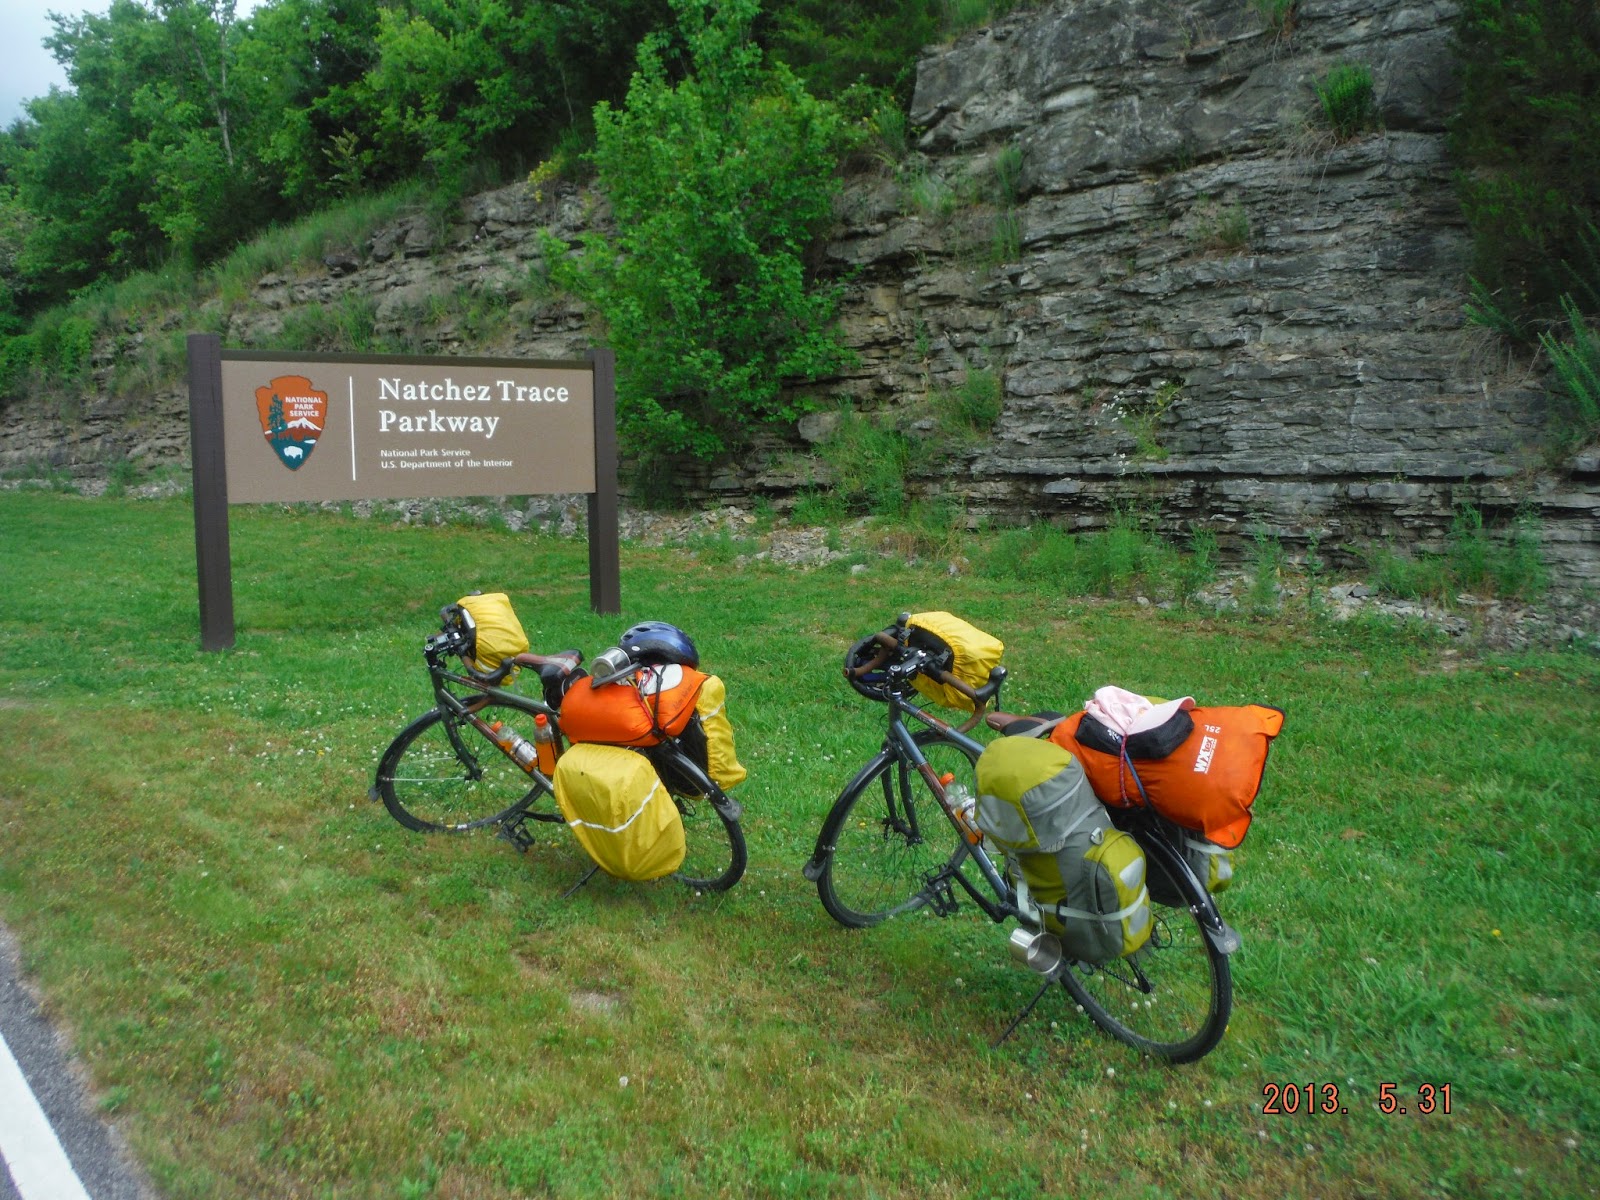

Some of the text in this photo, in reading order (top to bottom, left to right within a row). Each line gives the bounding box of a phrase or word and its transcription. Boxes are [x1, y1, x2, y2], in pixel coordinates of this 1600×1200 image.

[378, 377, 569, 402] Natchez Trace
[285, 396, 323, 404] NATIONAL
[378, 408, 500, 439] Parkway
[380, 448, 471, 457] National Park Service
[380, 458, 513, 470] U.S. Department of the Interior
[1204, 724, 1221, 733] 25L
